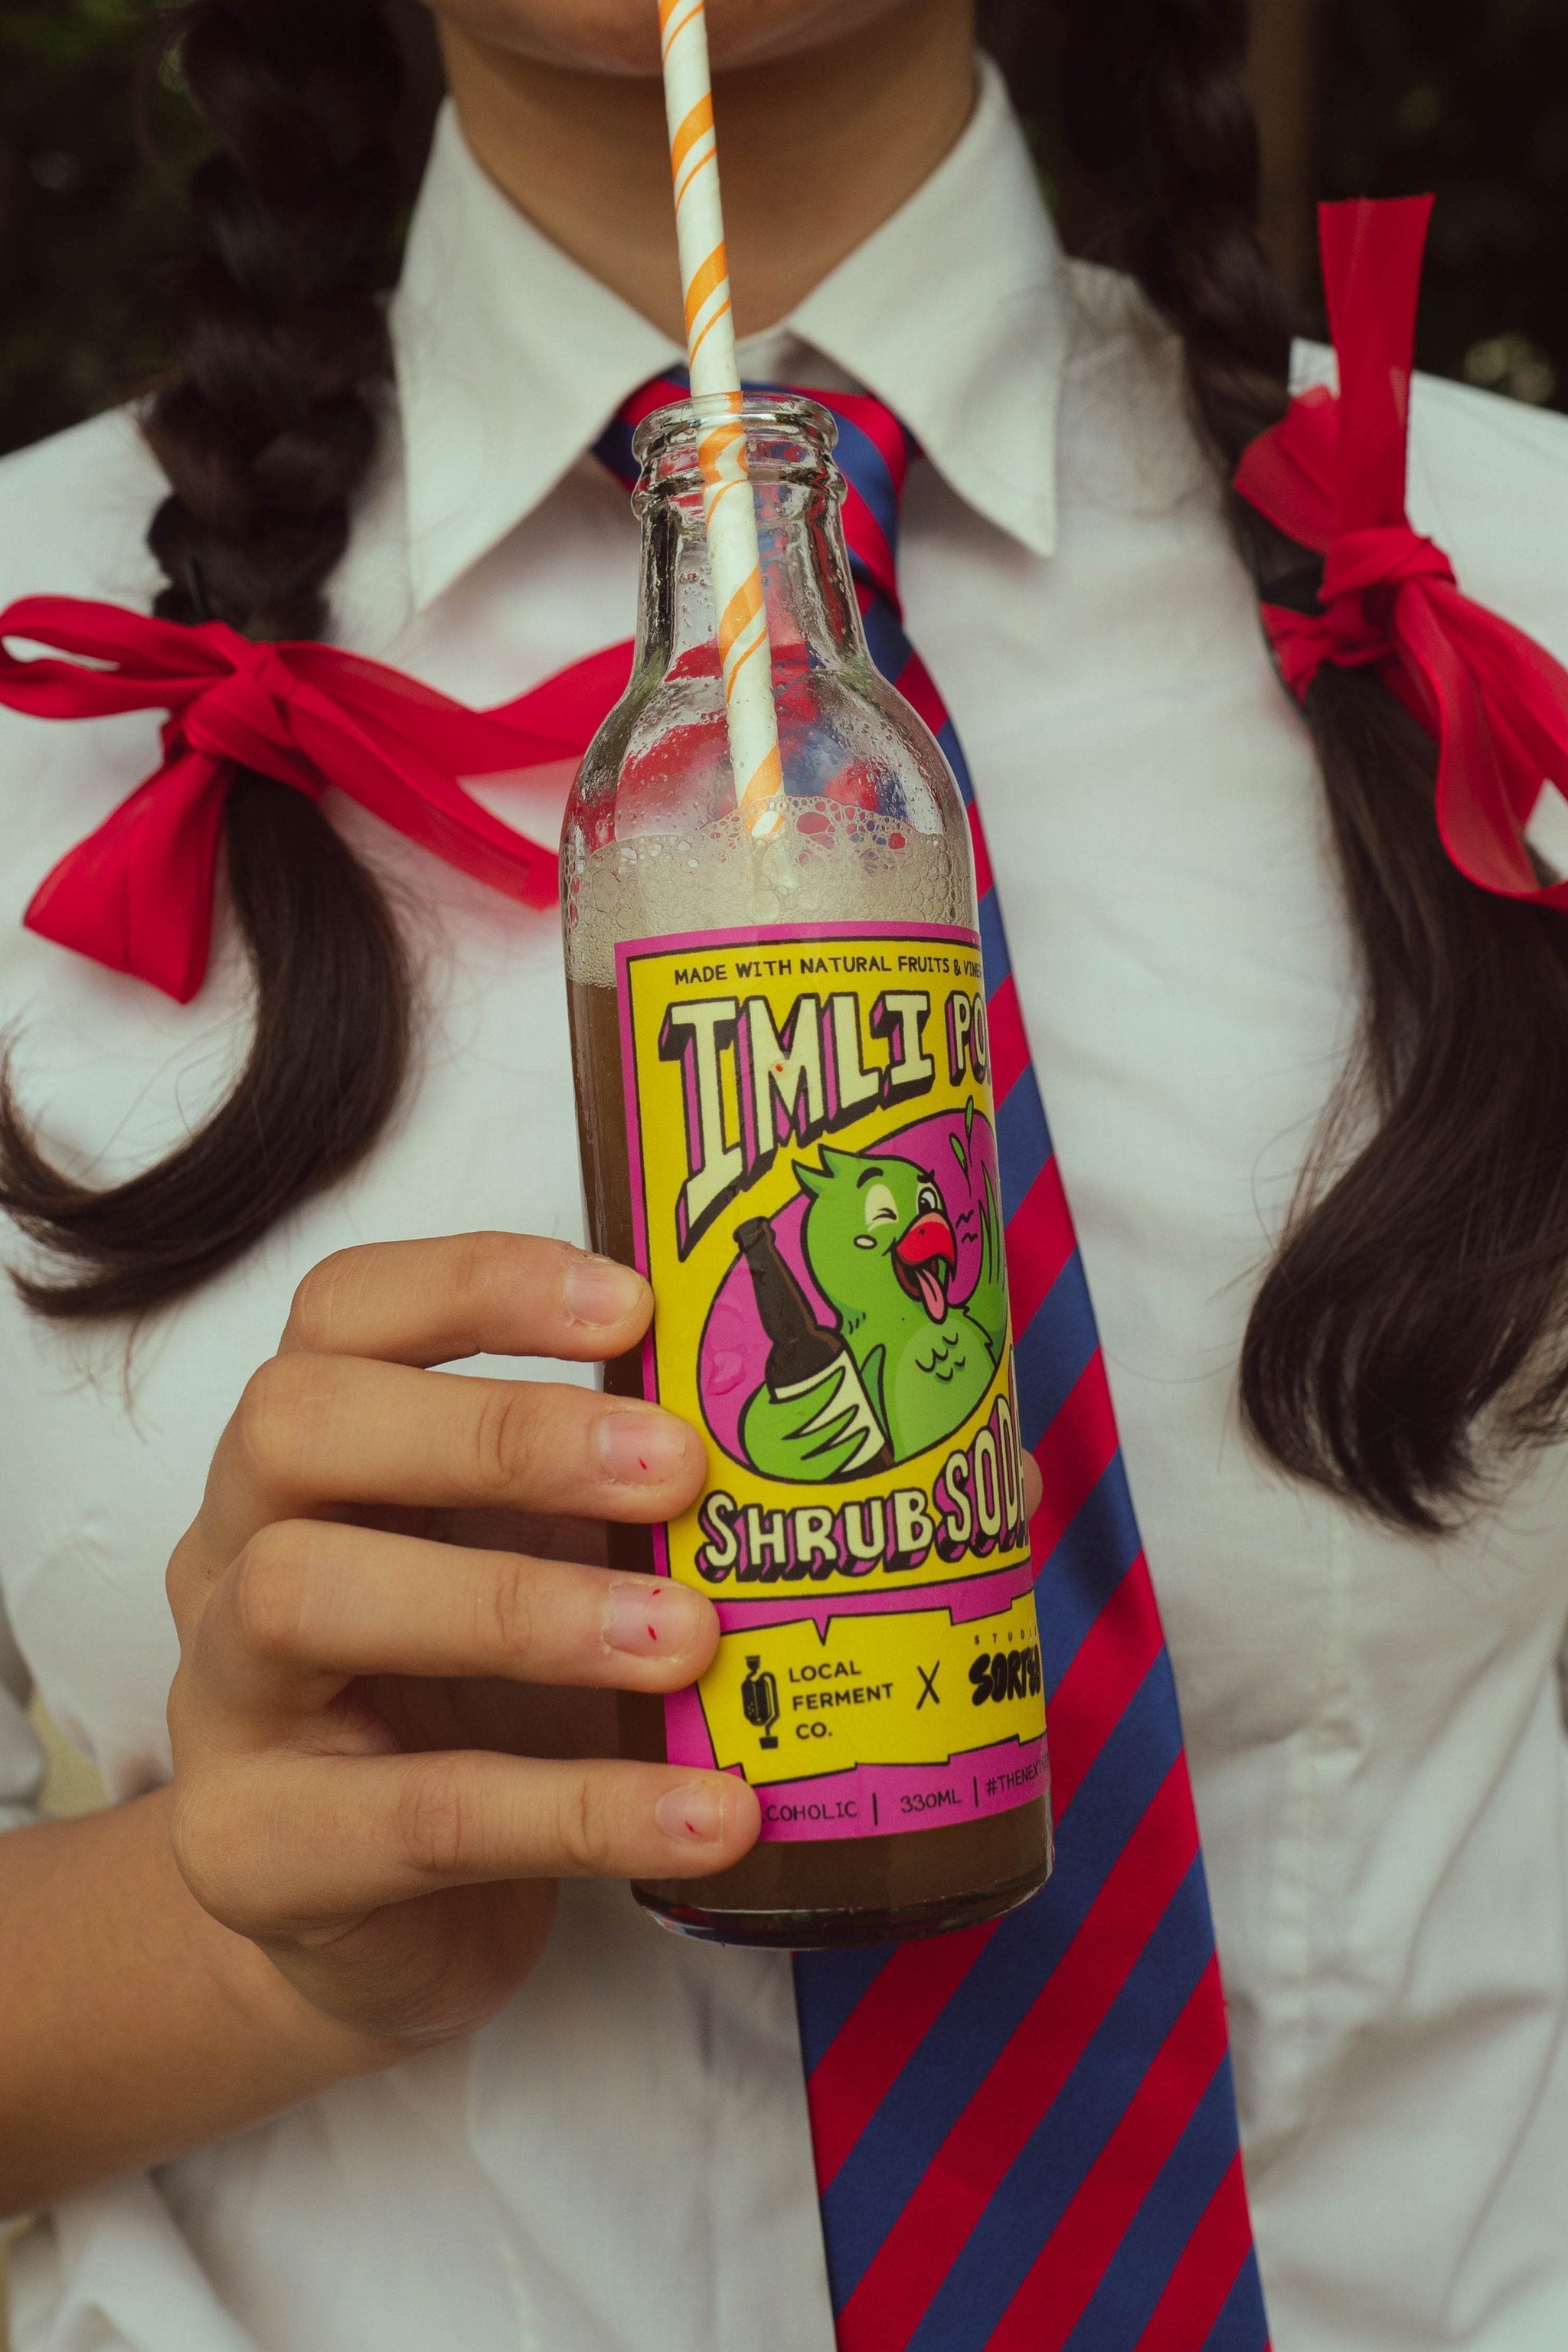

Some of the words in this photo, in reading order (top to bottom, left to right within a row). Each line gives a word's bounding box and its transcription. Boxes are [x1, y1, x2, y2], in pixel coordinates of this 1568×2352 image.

[675, 963, 727, 985] MADE
[735, 959, 792, 978] WITH
[800, 956, 892, 974] NATURAL
[897, 956, 950, 973] FRUITS
[952, 959, 962, 976] &
[658, 989, 936, 1263] IMLI
[789, 1660, 861, 1683] LOCAL
[916, 1660, 940, 1710] X
[792, 1683, 893, 1711] FERMENT
[795, 1722, 832, 1740] CO.
[900, 1788, 962, 1814] 330ML
